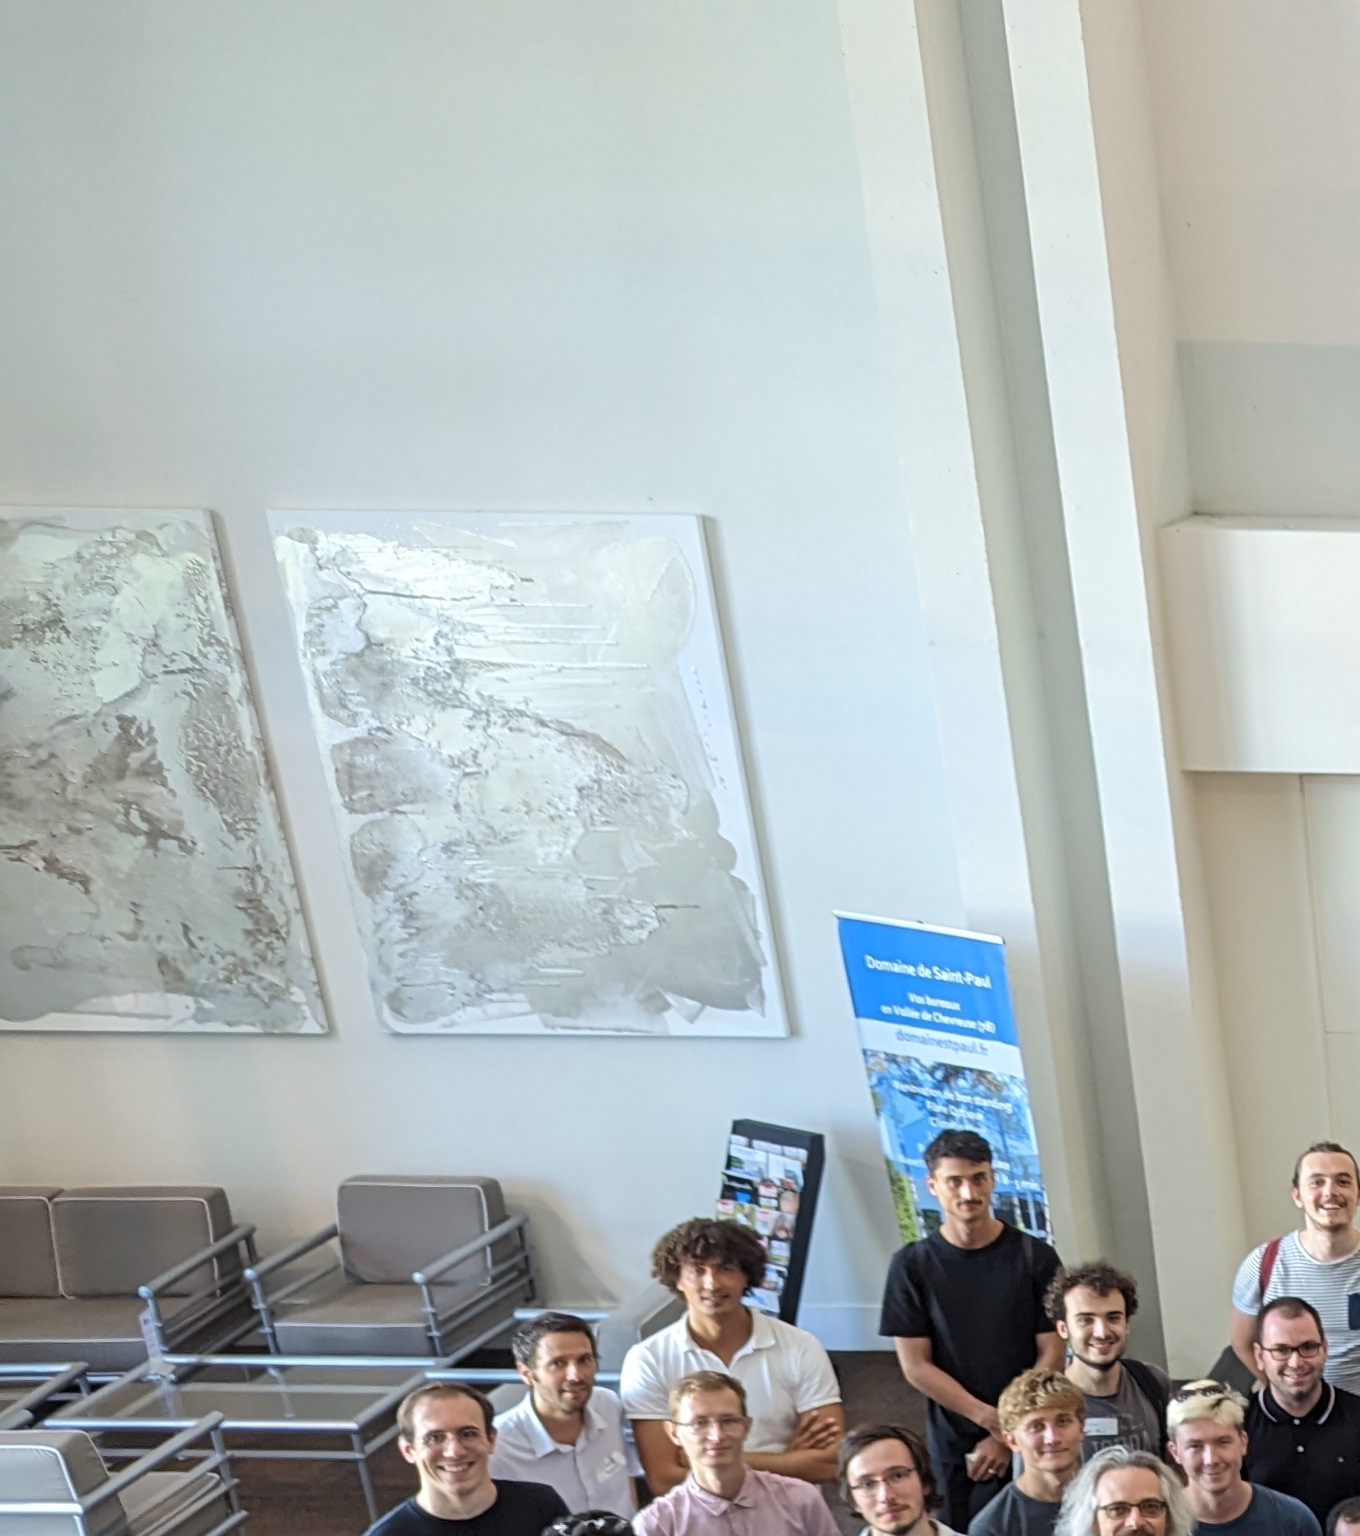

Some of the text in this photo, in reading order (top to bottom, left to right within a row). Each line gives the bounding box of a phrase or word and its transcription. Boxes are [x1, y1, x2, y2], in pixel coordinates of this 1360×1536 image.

[864, 955, 992, 989] Domaine de Saint-Paul
